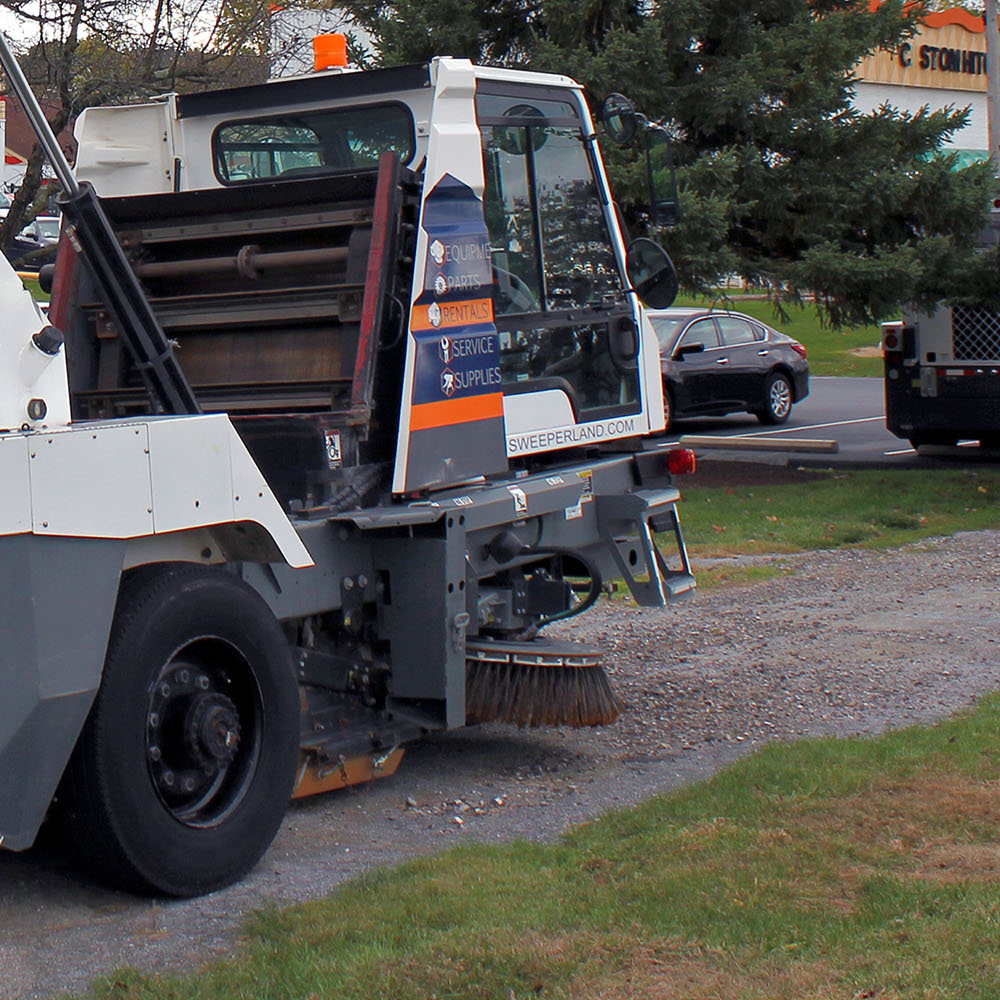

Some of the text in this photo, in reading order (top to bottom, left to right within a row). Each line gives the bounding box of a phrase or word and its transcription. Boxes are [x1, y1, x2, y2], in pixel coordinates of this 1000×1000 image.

[448, 274, 481, 291] PARTS
[442, 303, 489, 323] RENTALS
[452, 336, 494, 357] SERVICE
[454, 367, 502, 389] SUPPLIES
[508, 419, 634, 452] SWEEPERLAND.COM
